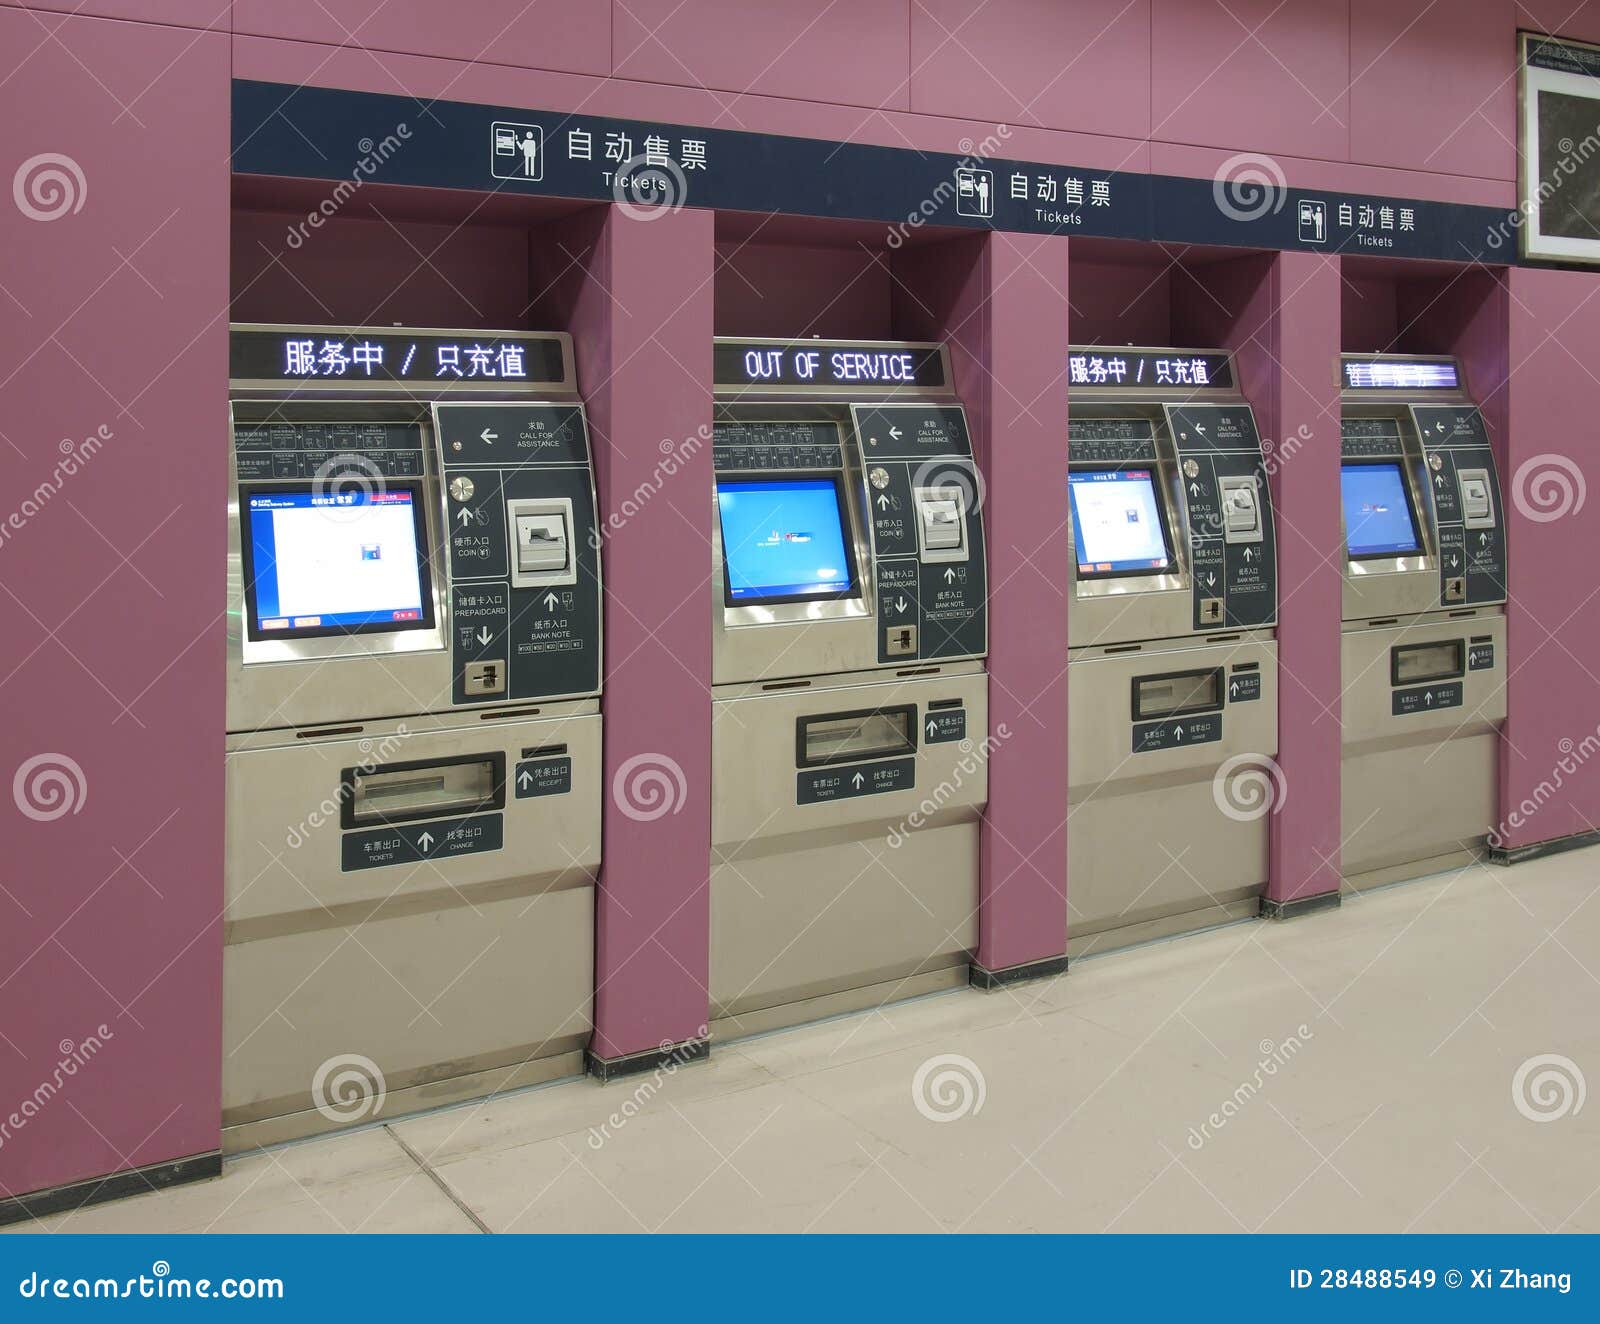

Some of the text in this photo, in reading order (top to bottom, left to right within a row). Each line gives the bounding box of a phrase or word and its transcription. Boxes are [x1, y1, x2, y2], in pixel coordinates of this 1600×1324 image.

[568, 128, 707, 170] 自动售票
[602, 172, 667, 190] Tickets
[1011, 172, 1111, 207] 自动售票
[1035, 209, 1082, 225] Tickets
[1339, 203, 1414, 231] 自动售票
[1358, 234, 1393, 247] Tickets
[284, 340, 384, 375] 服务中
[436, 344, 526, 377] 只充值
[745, 351, 915, 380] OUT OF SERVICE
[1069, 356, 1127, 383] 服务中
[1156, 358, 1210, 384] 只充值
[517, 440, 560, 448] ASSISTANCE
[454, 537, 489, 546] 硬币入口
[458, 549, 477, 557] COIN
[458, 595, 502, 606] 储值卡入口
[454, 607, 506, 617] PREPAIDCARD
[534, 619, 568, 630] 纸币入口
[531, 632, 551, 640] BANK
[534, 766, 568, 779] 凭条出口
[538, 779, 563, 787] RECEIPT
[446, 827, 482, 841] 找零出口
[363, 838, 401, 853] 车票出口
[449, 841, 474, 849] CHANGE
[368, 852, 393, 863] TICKETS
